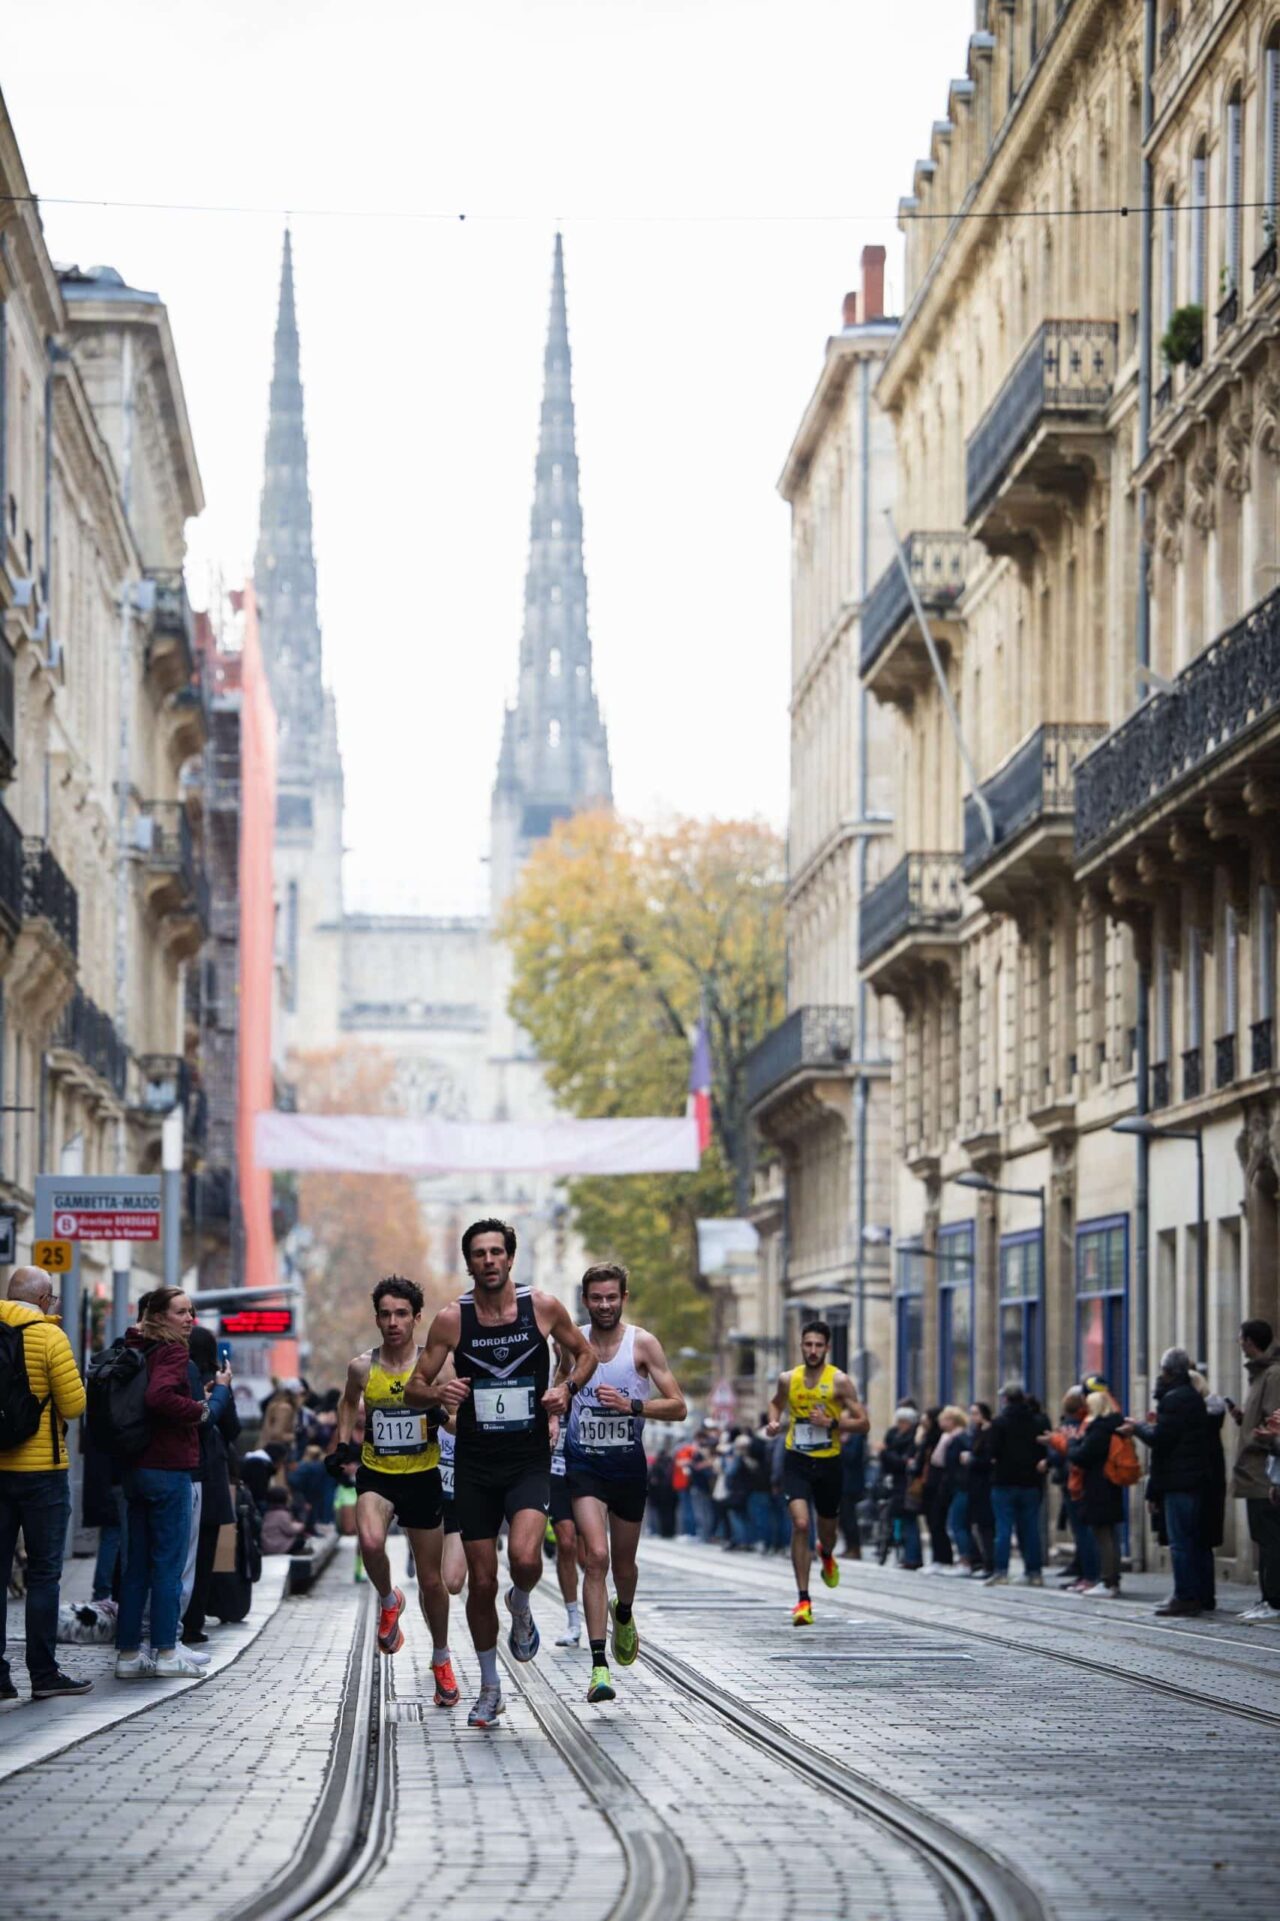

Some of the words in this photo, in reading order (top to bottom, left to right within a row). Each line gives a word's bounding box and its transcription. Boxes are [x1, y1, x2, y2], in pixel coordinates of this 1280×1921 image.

[62, 1219, 72, 1231] B
[42, 1247, 64, 1265] 25
[471, 1332, 529, 1348] BORDEAUX
[495, 1394, 505, 1414] 6
[376, 1421, 415, 1441] 2112
[580, 1421, 626, 1440] 15015
